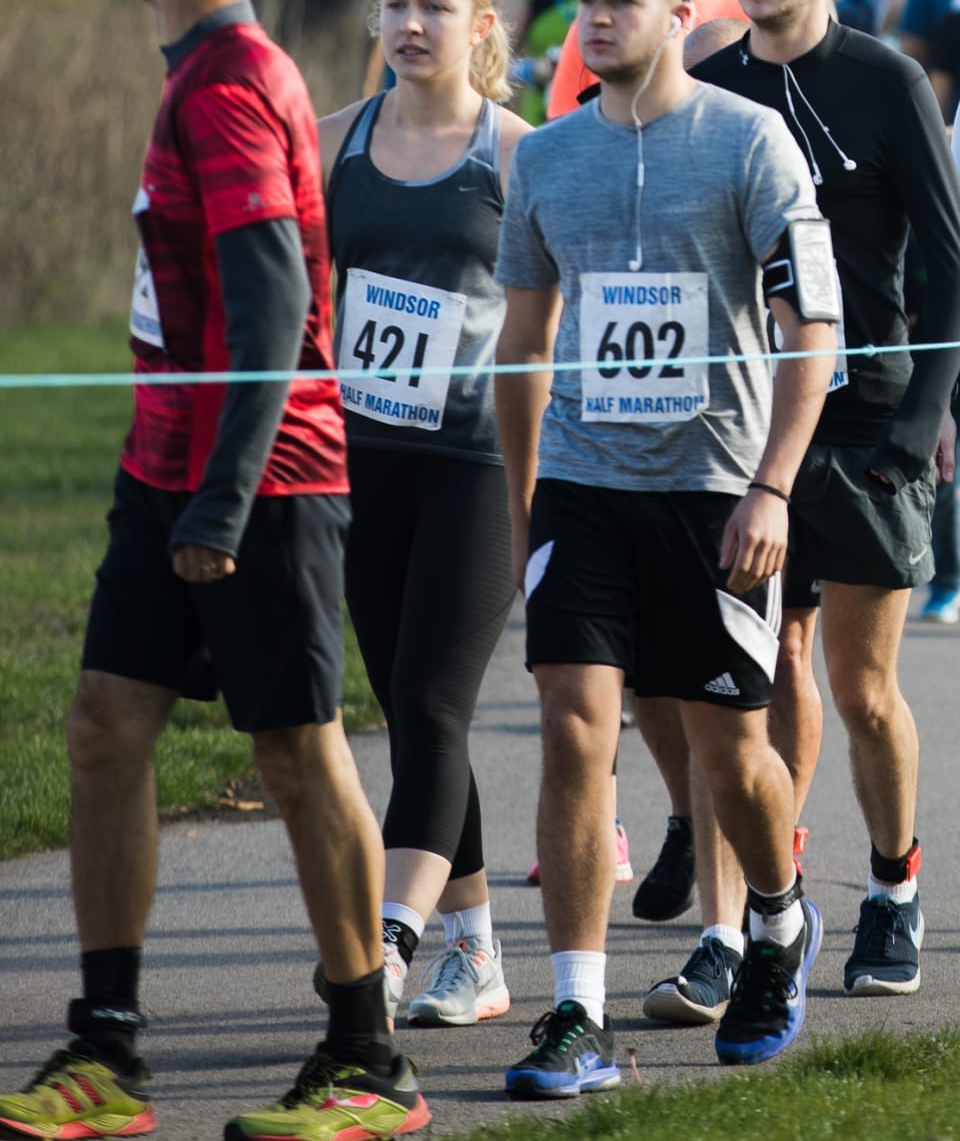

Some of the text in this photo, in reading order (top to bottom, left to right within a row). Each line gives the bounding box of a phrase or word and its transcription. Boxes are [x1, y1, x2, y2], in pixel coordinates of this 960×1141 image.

[366, 284, 441, 319] WINDSOR
[602, 286, 682, 305] WINDSOR
[352, 319, 429, 388] 421
[597, 321, 685, 379] 602
[340, 383, 440, 424] HALF MARATHON
[586, 397, 614, 413] HALF
[704, 684, 740, 695] adidas
